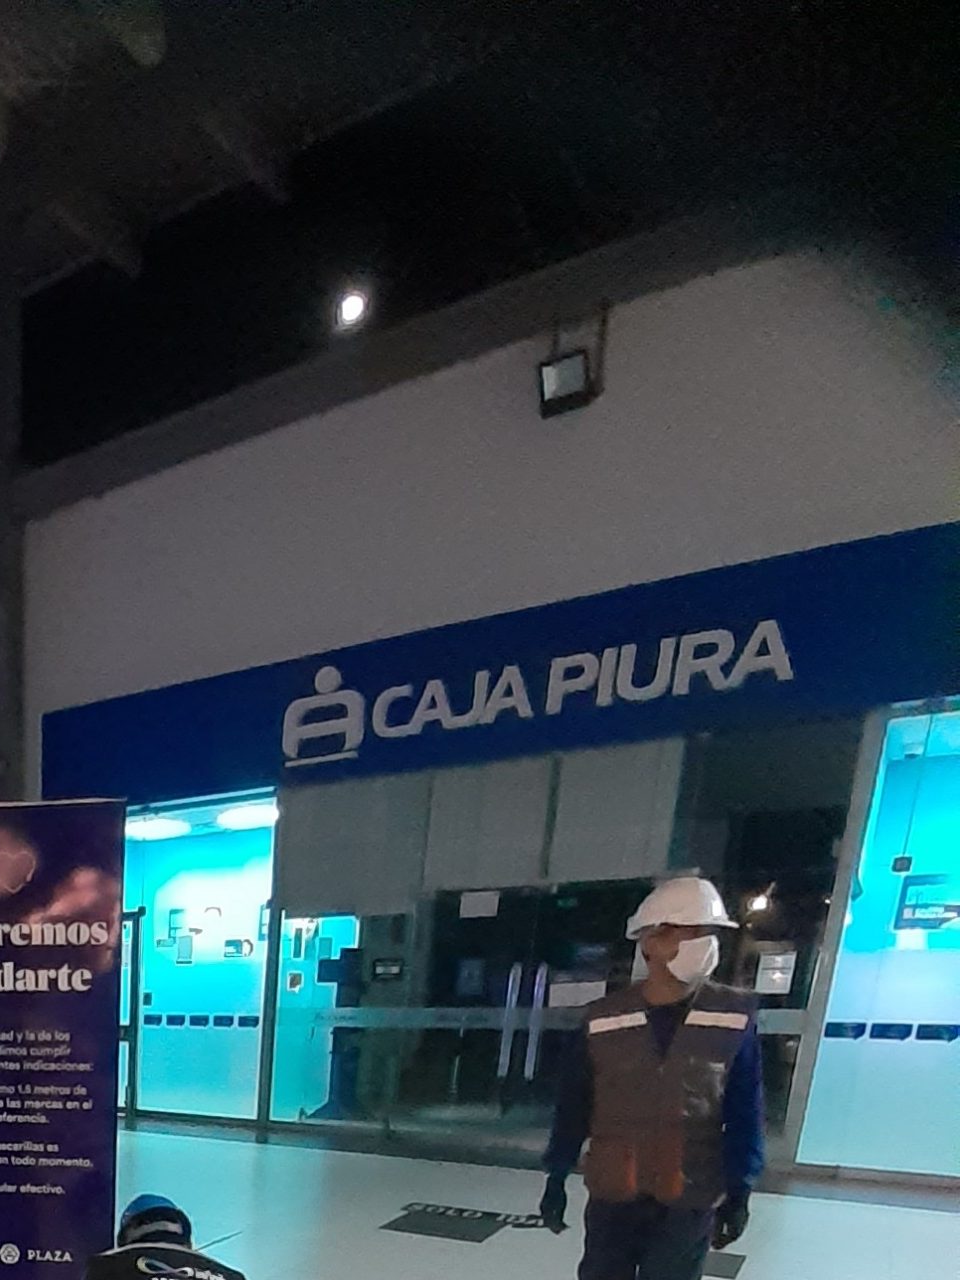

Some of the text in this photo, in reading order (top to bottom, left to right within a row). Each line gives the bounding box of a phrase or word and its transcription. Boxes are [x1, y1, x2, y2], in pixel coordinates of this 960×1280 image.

[372, 619, 795, 739] CAJA PIURA
[16, 1032, 23, 1043] y
[25, 1030, 36, 1041] la
[37, 1030, 52, 1041] de
[54, 1030, 71, 1042] los
[29, 1045, 72, 1058] cumplir
[23, 1060, 94, 1072] indicaciones:
[33, 1085, 71, 1096] metros
[73, 1085, 88, 1096] de
[6, 1098, 22, 1109] las
[24, 1099, 64, 1110] marcas
[66, 1100, 80, 1110] en
[82, 1099, 93, 1110] el
[47, 1142, 59, 1152] es
[11, 1154, 36, 1166] todo
[38, 1156, 94, 1168] momento.
[20, 1182, 66, 1195] efectivo.
[407, 1203, 483, 1219] SOLO
[27, 1250, 73, 1262] PLAZA
